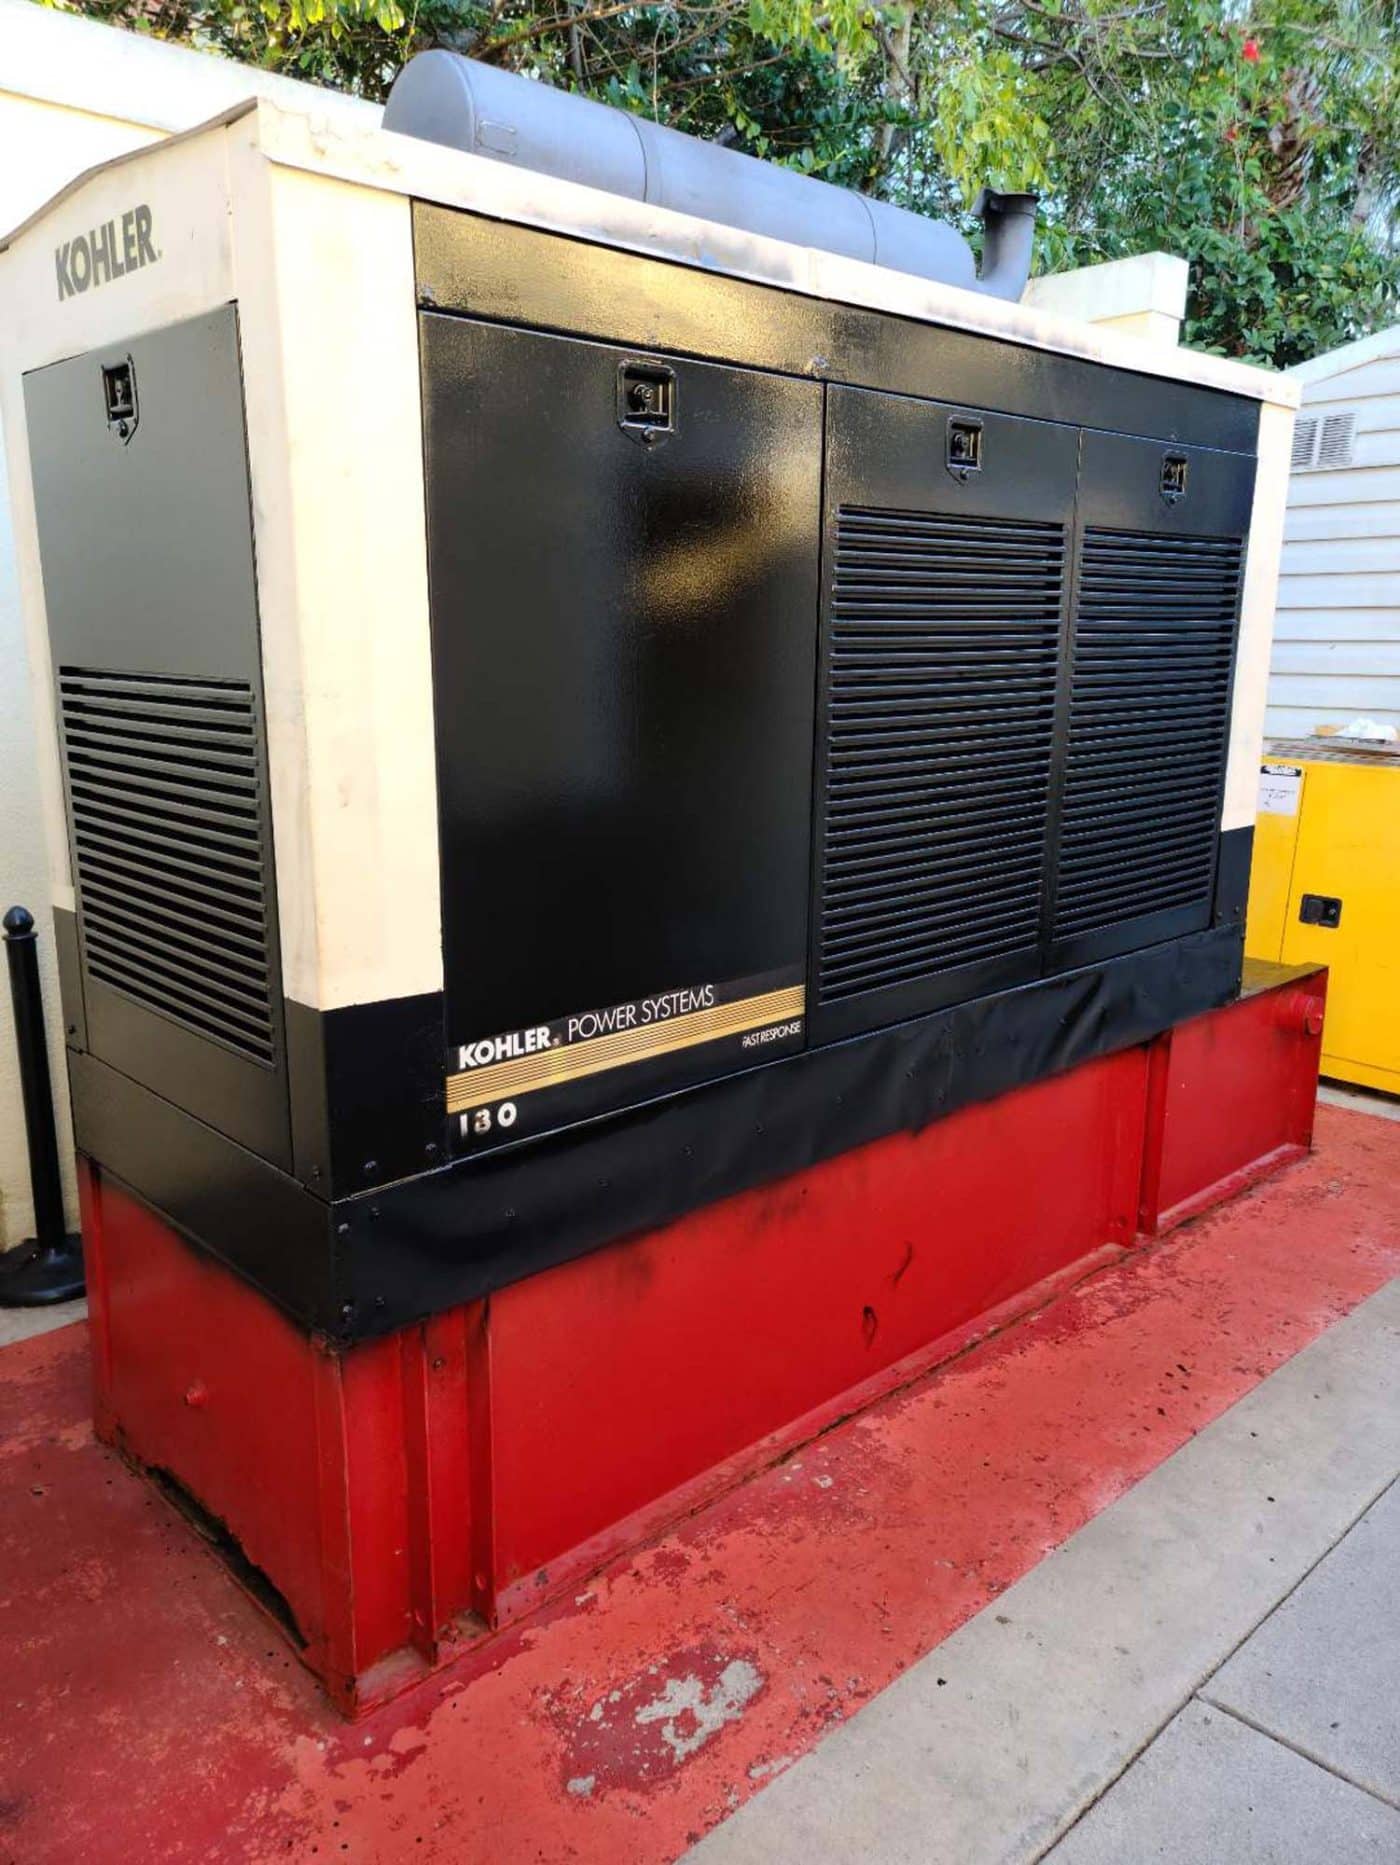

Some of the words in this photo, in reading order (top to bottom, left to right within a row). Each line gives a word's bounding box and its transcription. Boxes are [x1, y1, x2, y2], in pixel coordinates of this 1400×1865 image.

[55, 204, 158, 302] KOHLER
[459, 1026, 552, 1070] KOHLER
[568, 1004, 637, 1042] POWER
[641, 984, 715, 1023] SYSTEMS
